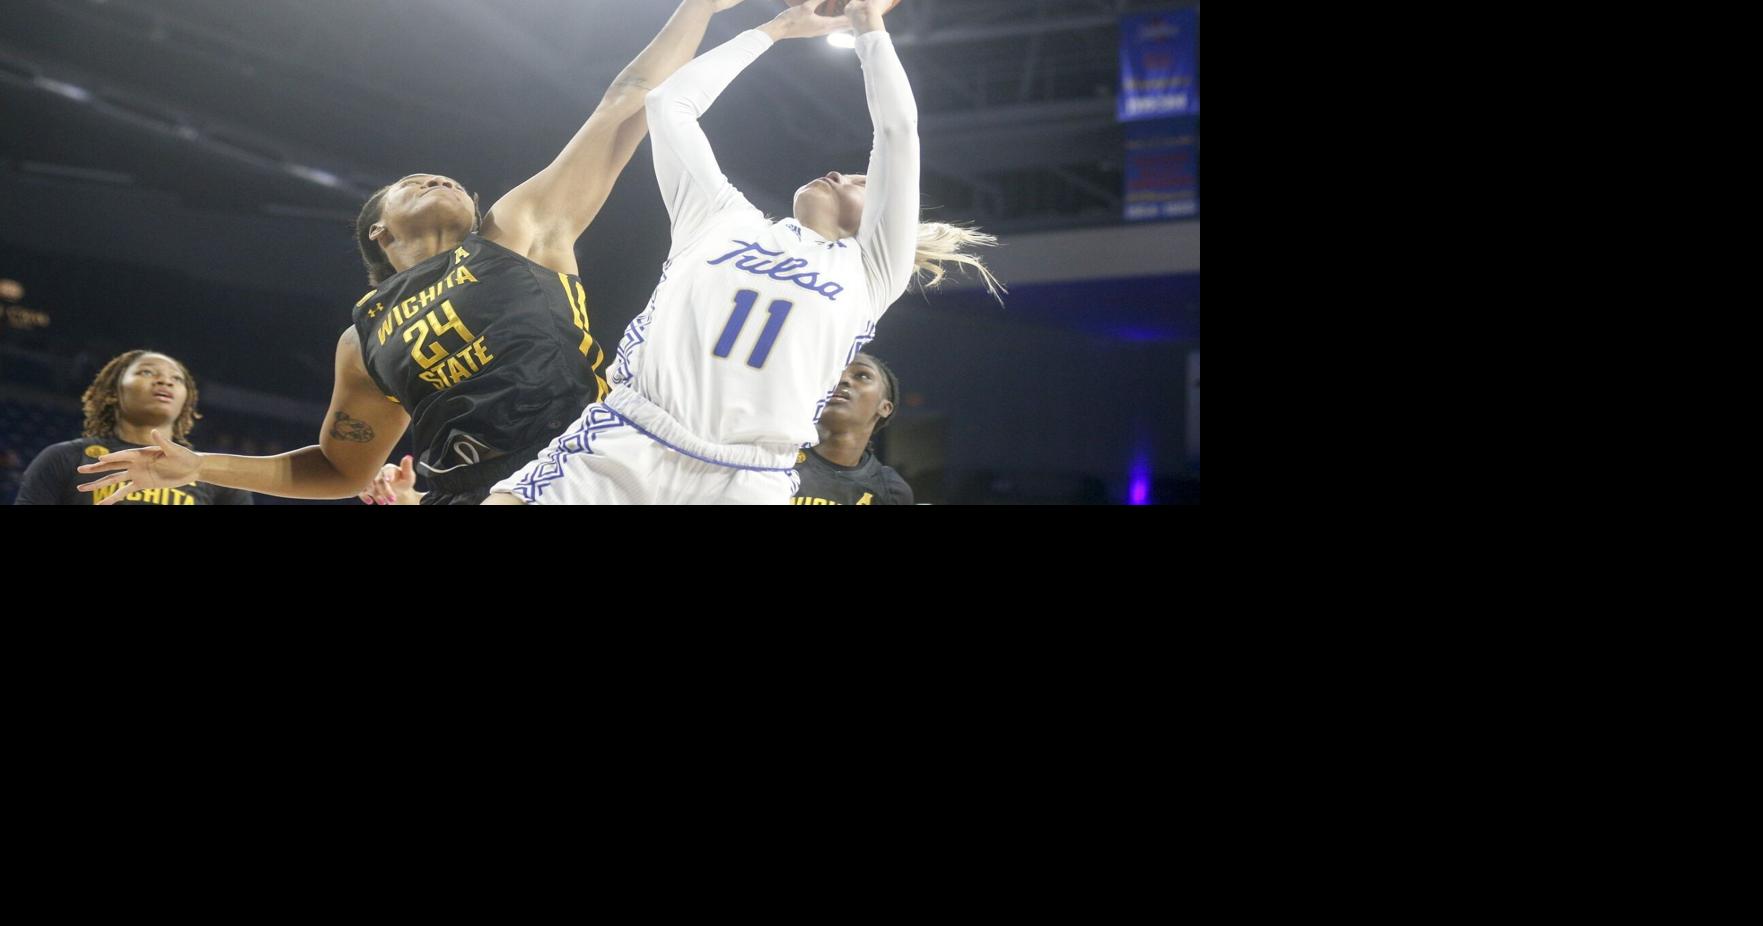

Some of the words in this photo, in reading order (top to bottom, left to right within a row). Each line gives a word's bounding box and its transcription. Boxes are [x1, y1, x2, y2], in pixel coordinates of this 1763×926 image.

[377, 265, 479, 346] WICHITA
[706, 239, 844, 301] Tulsa
[402, 299, 476, 370] 24
[418, 335, 494, 391] STATE
[712, 288, 793, 370] 11
